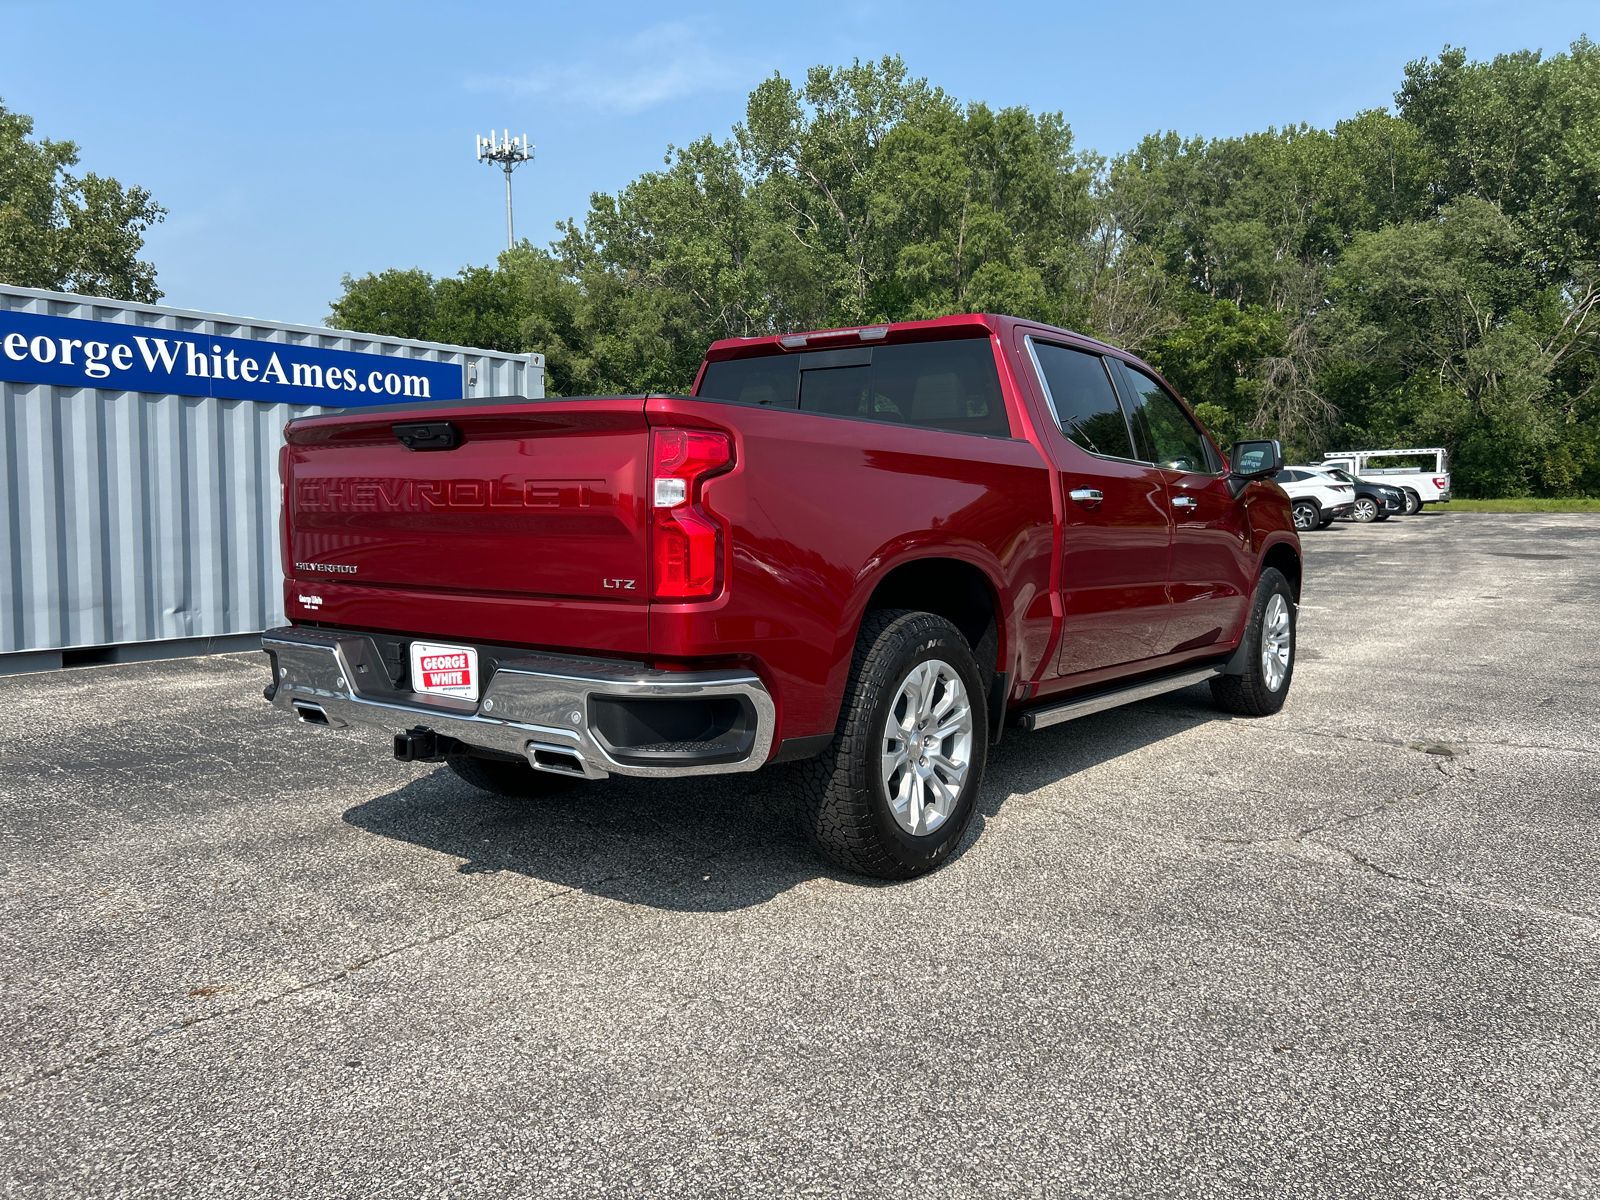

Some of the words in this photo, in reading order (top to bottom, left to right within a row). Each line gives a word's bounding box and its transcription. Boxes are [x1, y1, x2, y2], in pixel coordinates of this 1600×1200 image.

[0, 333, 432, 398] eorgeWhiteAmes.com
[299, 479, 606, 507] CHEVROLET
[295, 562, 358, 574] SILVERADO
[603, 578, 636, 590] LTZ
[423, 655, 466, 670] GEORGE
[430, 671, 463, 686] WHITE
